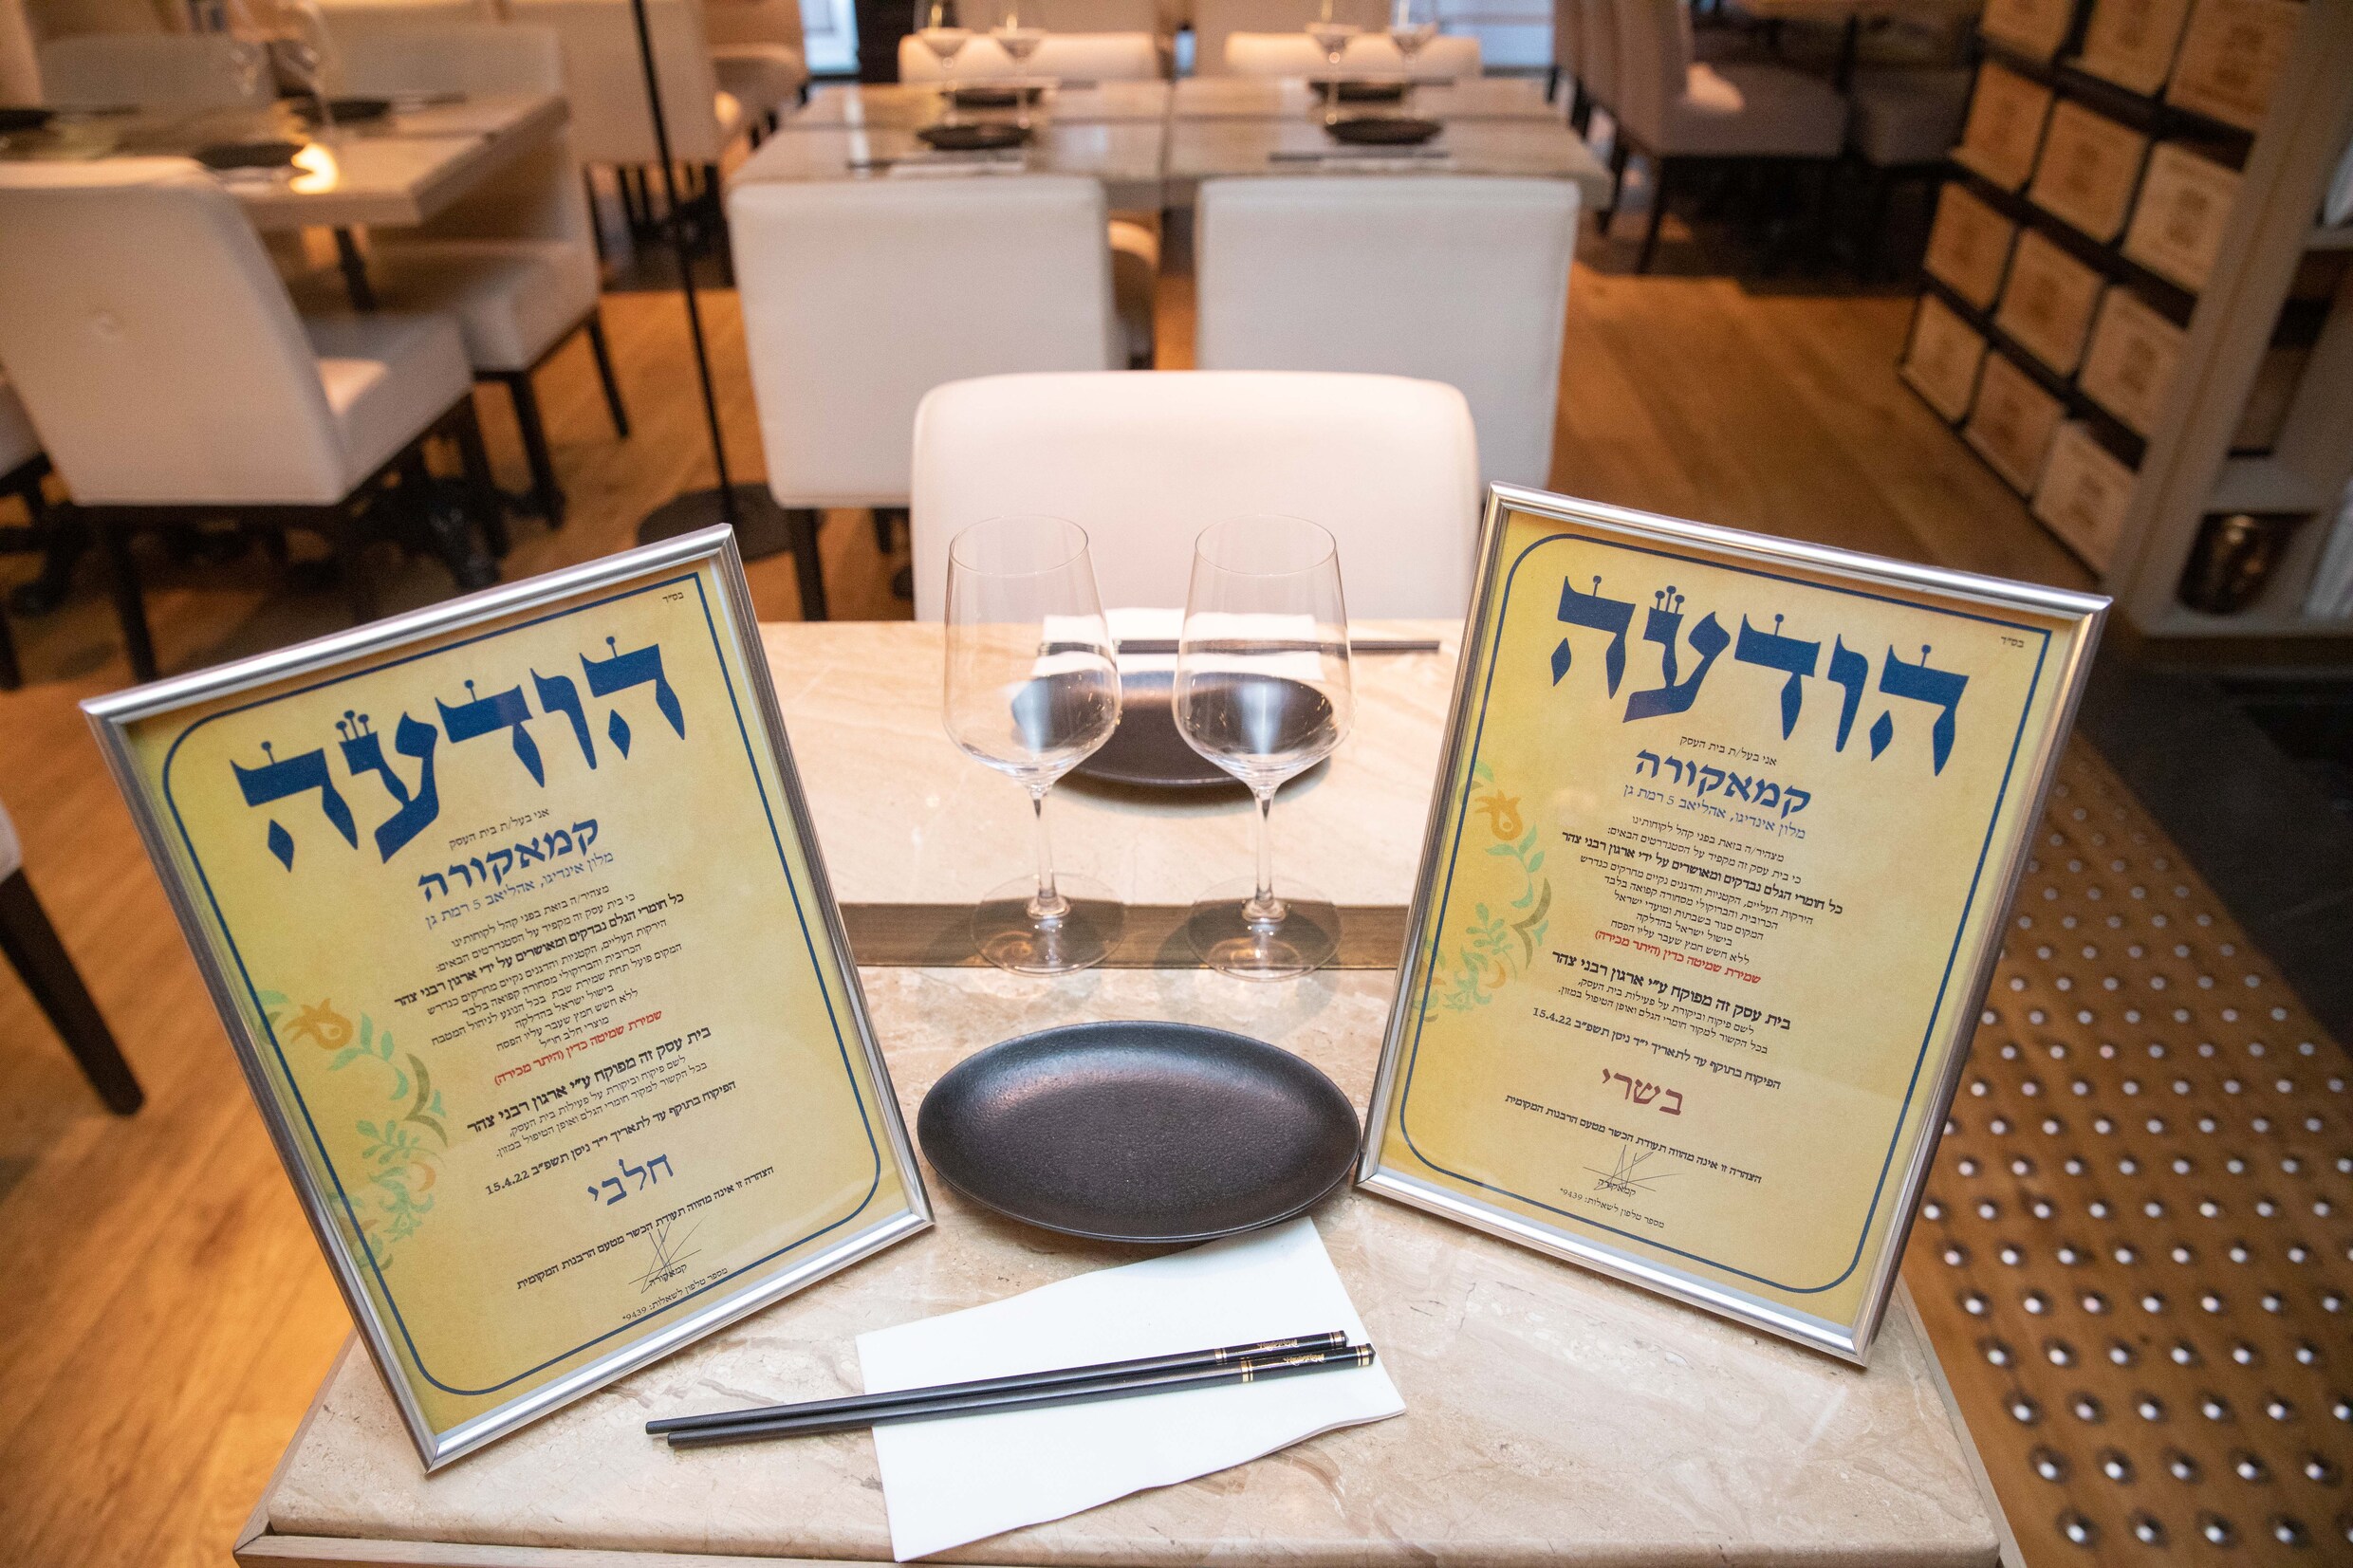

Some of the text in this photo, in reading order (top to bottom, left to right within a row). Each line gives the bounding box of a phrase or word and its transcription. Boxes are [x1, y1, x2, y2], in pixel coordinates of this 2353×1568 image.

[1550, 575, 1969, 776] הודעה
[230, 636, 685, 872] הודעה
[1623, 784, 1634, 797] גן
[1635, 748, 1811, 820] קמאקורה
[1637, 787, 1664, 802] רמת
[1666, 795, 1674, 804] 5
[1677, 798, 1726, 819] אהליאב
[449, 808, 549, 850] אני בעל/ת בית העסק
[1676, 823, 1695, 839] קהל
[1778, 823, 1806, 839] מלון
[1696, 832, 1715, 844] בפני
[1717, 838, 1742, 851] בזאת
[417, 818, 599, 902] קמאקורה
[586, 852, 614, 872] מלון
[1580, 855, 1608, 869] כנדרש
[1744, 845, 1785, 862] מצהיר/ה
[1609, 862, 1644, 878] מחרקים
[1645, 872, 1668, 885] נקיים
[485, 880, 535, 905] אהליאב
[569, 885, 609, 903] מצהיר/ה
[1670, 878, 1703, 894] והדגנים
[472, 899, 481, 910] 5
[606, 897, 624, 910] בית
[624, 893, 636, 901] כי
[1603, 875, 1778, 930] הכרובית והברוקולי מסחורה קפואה בלבד
[1704, 888, 1742, 905] הקטניות
[440, 903, 469, 921] רמת
[543, 899, 568, 914] בזאת
[584, 904, 603, 919] עסק
[425, 914, 437, 930] גן
[496, 917, 518, 928] קהל
[520, 910, 542, 922] בפני
[541, 916, 571, 932] מקפיד
[572, 912, 582, 920] זה
[1780, 910, 1813, 925] הירקות
[525, 928, 539, 937] על
[1636, 913, 1732, 947] בישול ישראל בהדלקה
[393, 893, 684, 1006] כל חומרי הגלם נבדקים ומאושרים על ידי ארגון רבני צהר
[471, 933, 525, 959] הסטנדרטים
[1551, 950, 1578, 967] צהר
[1662, 949, 1684, 962] כדין
[1686, 955, 1722, 972] שמיטה
[1580, 958, 1608, 976] רבני
[1723, 967, 1761, 984] שמירת
[1609, 967, 1644, 987] ארגון
[431, 943, 682, 1045] המקום פועל תחת שמירת שבת בכל הנוגע לניהול המטבח
[1584, 989, 1614, 1007] הטיפול
[1605, 986, 1622, 996] בית
[1624, 990, 1656, 1005] פעילות
[1670, 985, 1713, 1007] מפוקח
[514, 985, 614, 1028] בישול ישראל בהדלקה
[1615, 1002, 1637, 1014] ואופן
[1658, 997, 1670, 1010] על
[1714, 998, 1731, 1012] זה
[495, 987, 638, 1051] ללא חשש חמץ שעבר עליו הפסח
[627, 1010, 662, 1031] שמירת
[1638, 1007, 1661, 1021] הגלם
[1671, 1005, 1706, 1021] וביקורת
[1707, 1015, 1732, 1028] פיקוח
[1732, 1004, 1762, 1022] עסק
[1764, 1013, 1791, 1030] בית
[584, 1016, 609, 1028] מוצרי
[1662, 1016, 1687, 1029] חומרי
[1732, 1023, 1754, 1034] לשם
[563, 1026, 583, 1040] חלב
[588, 1024, 624, 1046] שמיטה
[686, 1026, 712, 1044] בית
[1689, 1024, 1716, 1038] למקור
[1718, 1033, 1748, 1047] הקשור
[1750, 1039, 1768, 1054] בכל
[565, 1040, 588, 1059] כדין
[638, 1049, 653, 1064] זה
[655, 1037, 682, 1061] עסק
[593, 1057, 637, 1082] מפוקח
[530, 1084, 568, 1112] ארגון
[701, 1080, 736, 1101] הפיקוח
[1602, 1068, 1683, 1116] בשרי
[497, 1100, 530, 1120] רבני
[668, 1096, 701, 1117] בתוקף
[468, 1114, 495, 1133] צהר
[652, 1110, 666, 1121] עד
[609, 1115, 651, 1142] לתאריך
[1504, 1095, 1762, 1184] הצהרה זו אינה מהווה תעודת הכשר מטעם הרבנות המקומית
[569, 1143, 591, 1161] ניסן
[485, 1170, 530, 1195] 15.4.22
[586, 1153, 674, 1206] חלבי
[1620, 1208, 1641, 1221] טלפון
[1643, 1216, 1664, 1228] מספר
